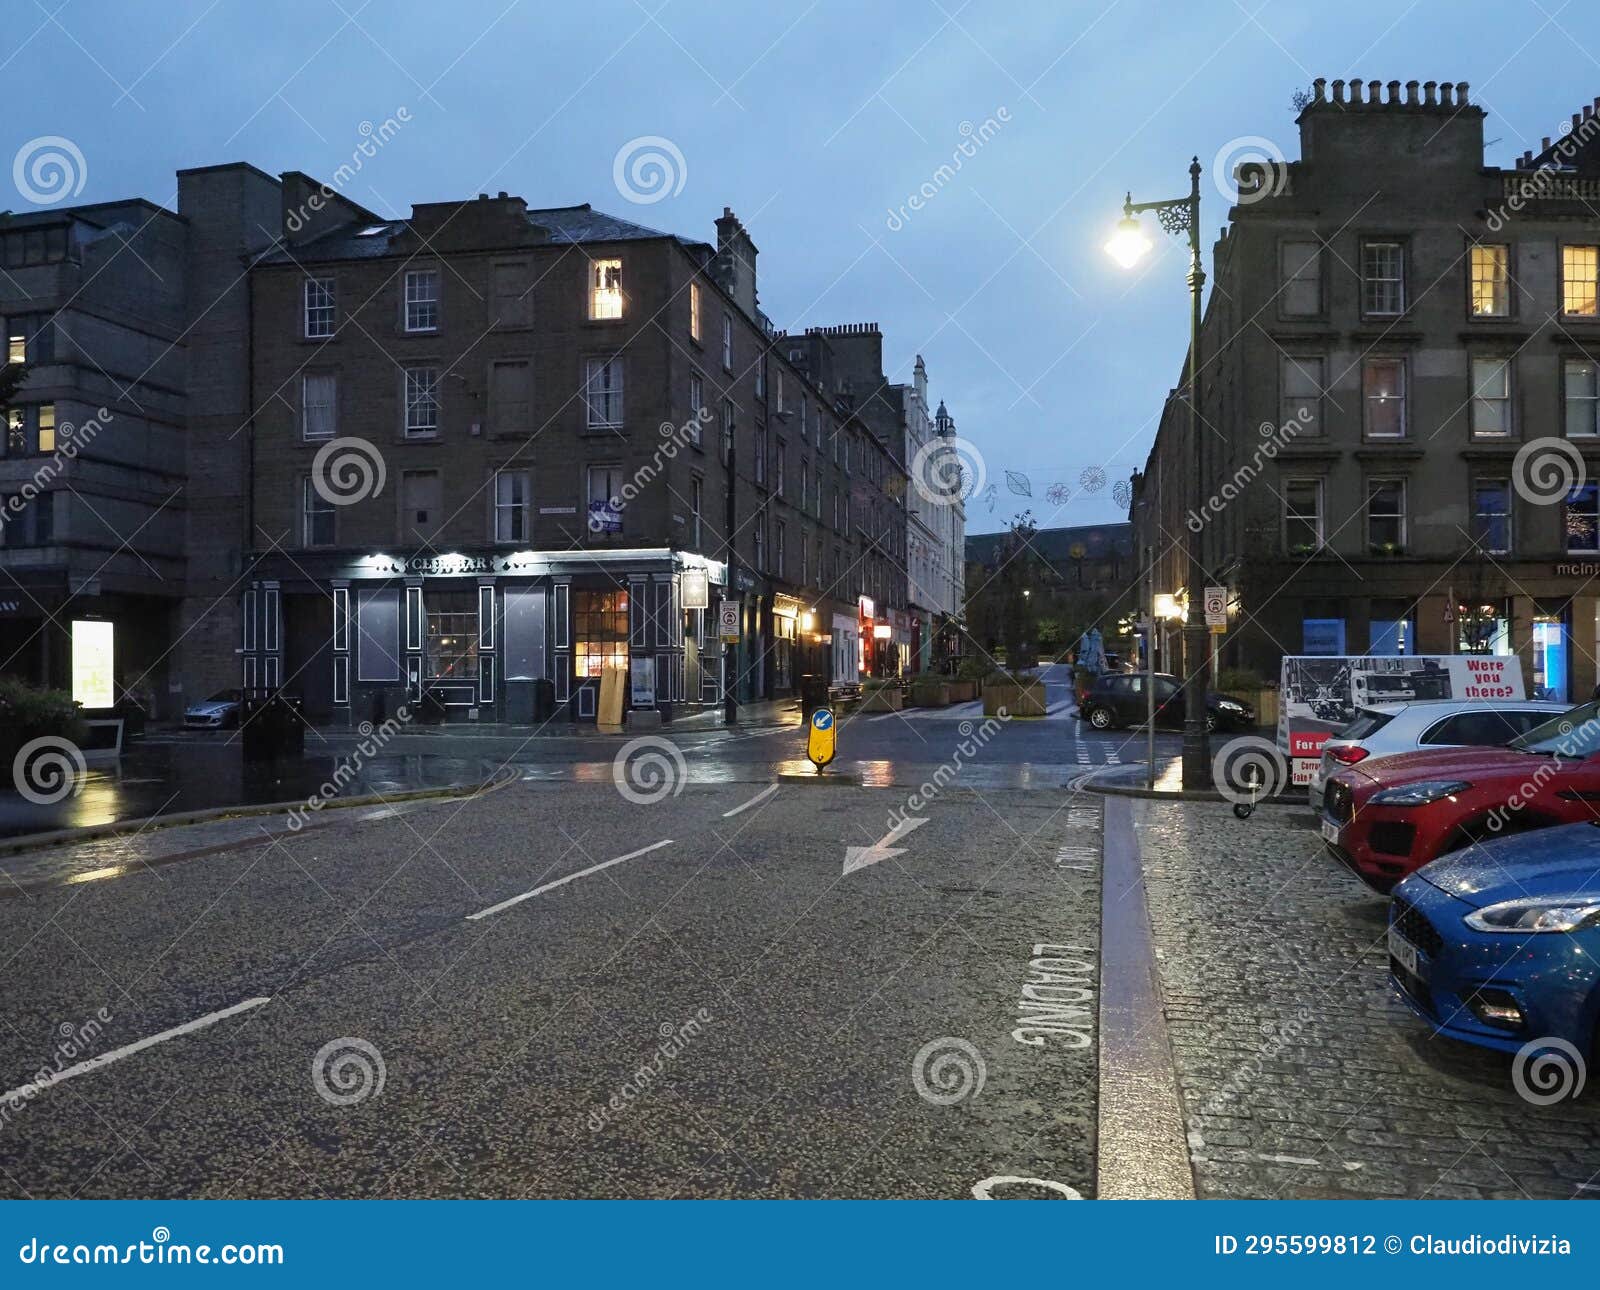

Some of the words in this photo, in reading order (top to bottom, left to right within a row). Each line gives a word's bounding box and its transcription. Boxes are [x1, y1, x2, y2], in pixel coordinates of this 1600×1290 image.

[1466, 659, 1505, 671] Were
[1474, 673, 1501, 684] you
[1465, 686, 1514, 698] there?
[1295, 740, 1313, 750] For
[1011, 943, 1096, 1049] LOADING
